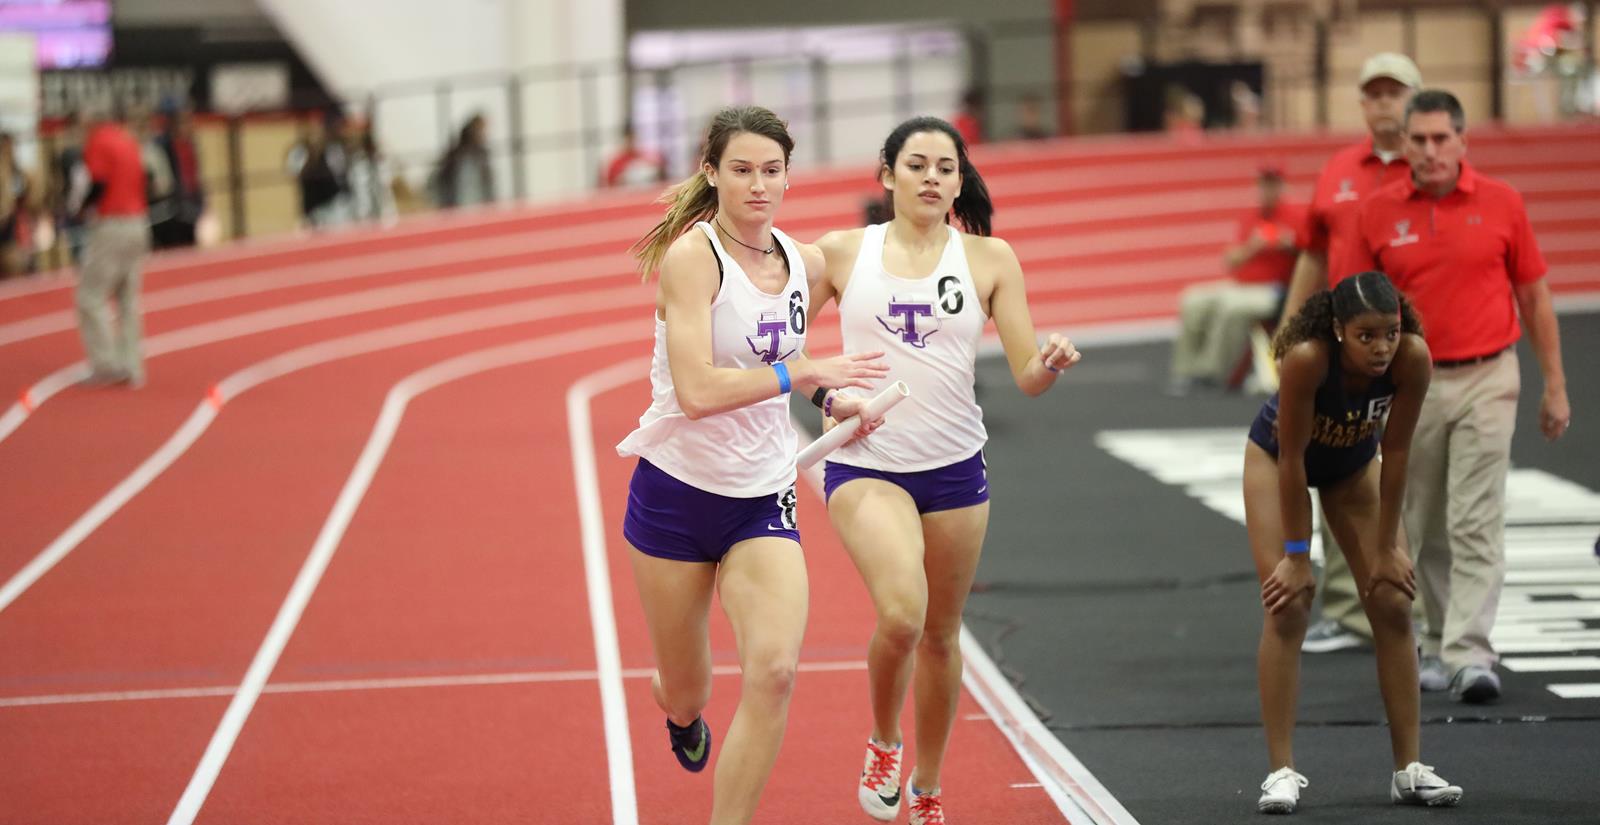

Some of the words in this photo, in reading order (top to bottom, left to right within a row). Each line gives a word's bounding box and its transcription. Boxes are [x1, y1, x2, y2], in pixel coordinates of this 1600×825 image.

[789, 290, 805, 335] 6
[938, 276, 964, 314] 6
[888, 302, 933, 342] T
